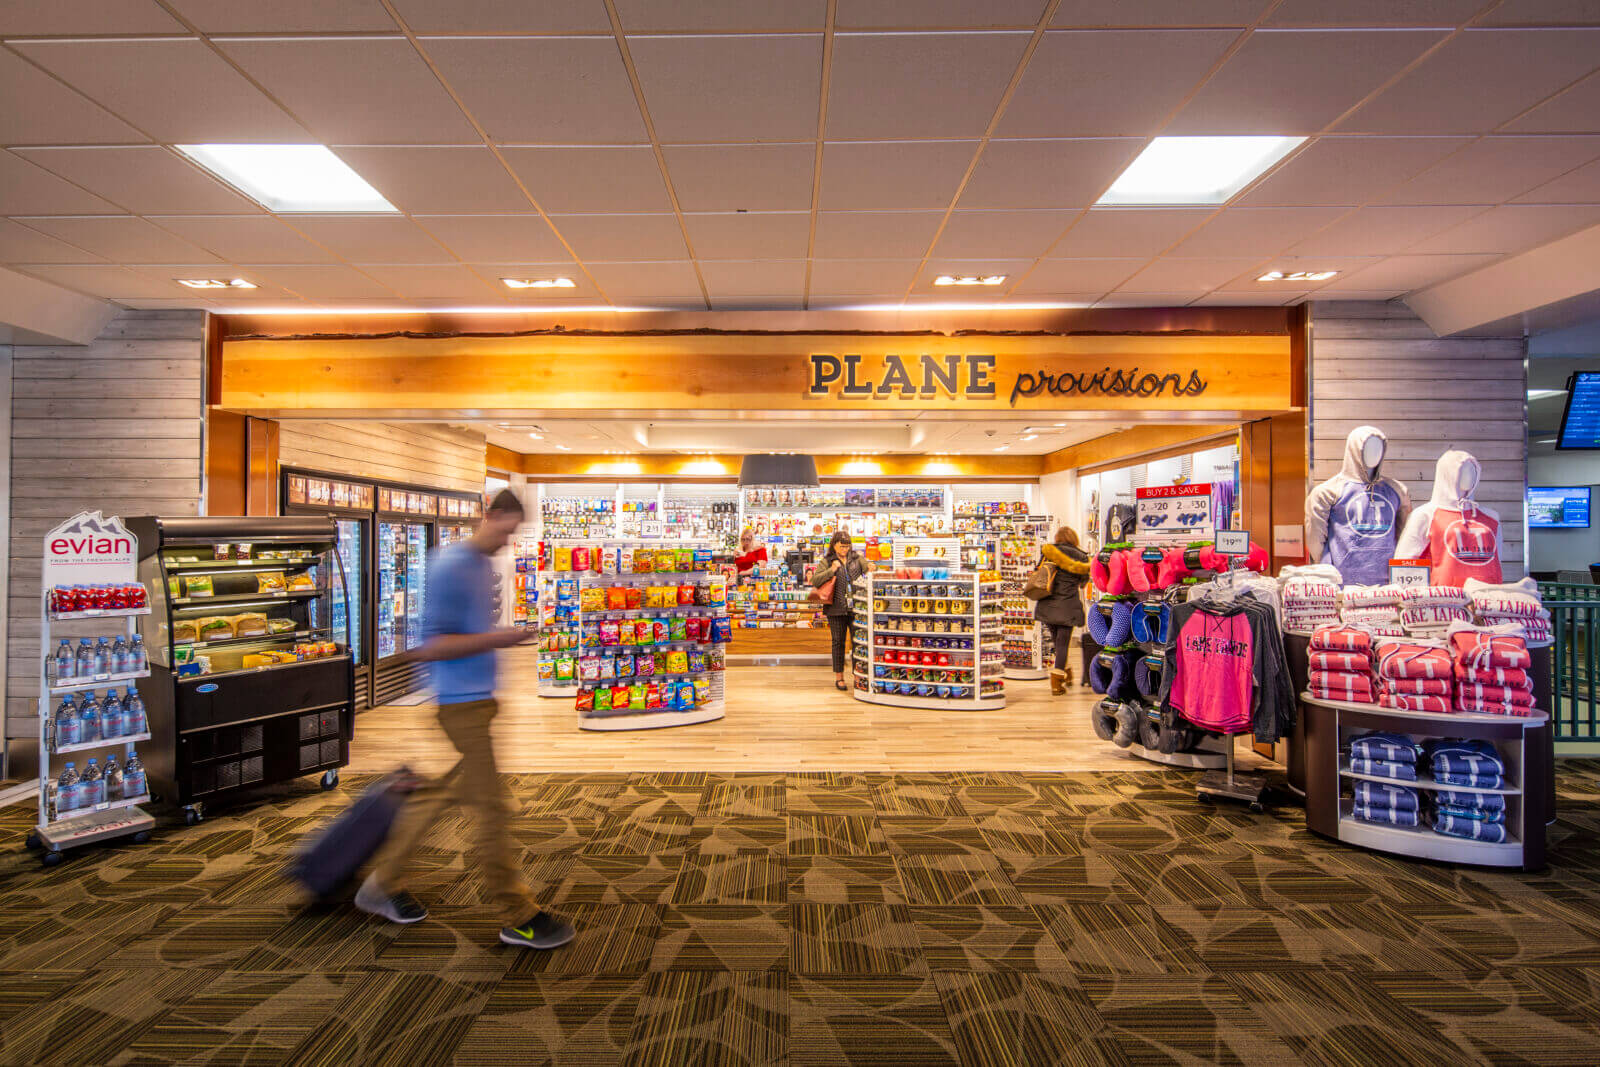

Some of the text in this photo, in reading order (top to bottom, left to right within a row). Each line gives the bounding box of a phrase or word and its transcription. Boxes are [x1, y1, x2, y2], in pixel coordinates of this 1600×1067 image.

[810, 354, 1208, 407] PLANE provisions
[1146, 486, 1200, 497] BUY 2 & SAVE
[1140, 503, 1146, 512] 2
[1176, 501, 1182, 510] 2
[50, 534, 131, 555] evian
[1404, 607, 1428, 624] AKE
[1431, 606, 1467, 622] TAHO
